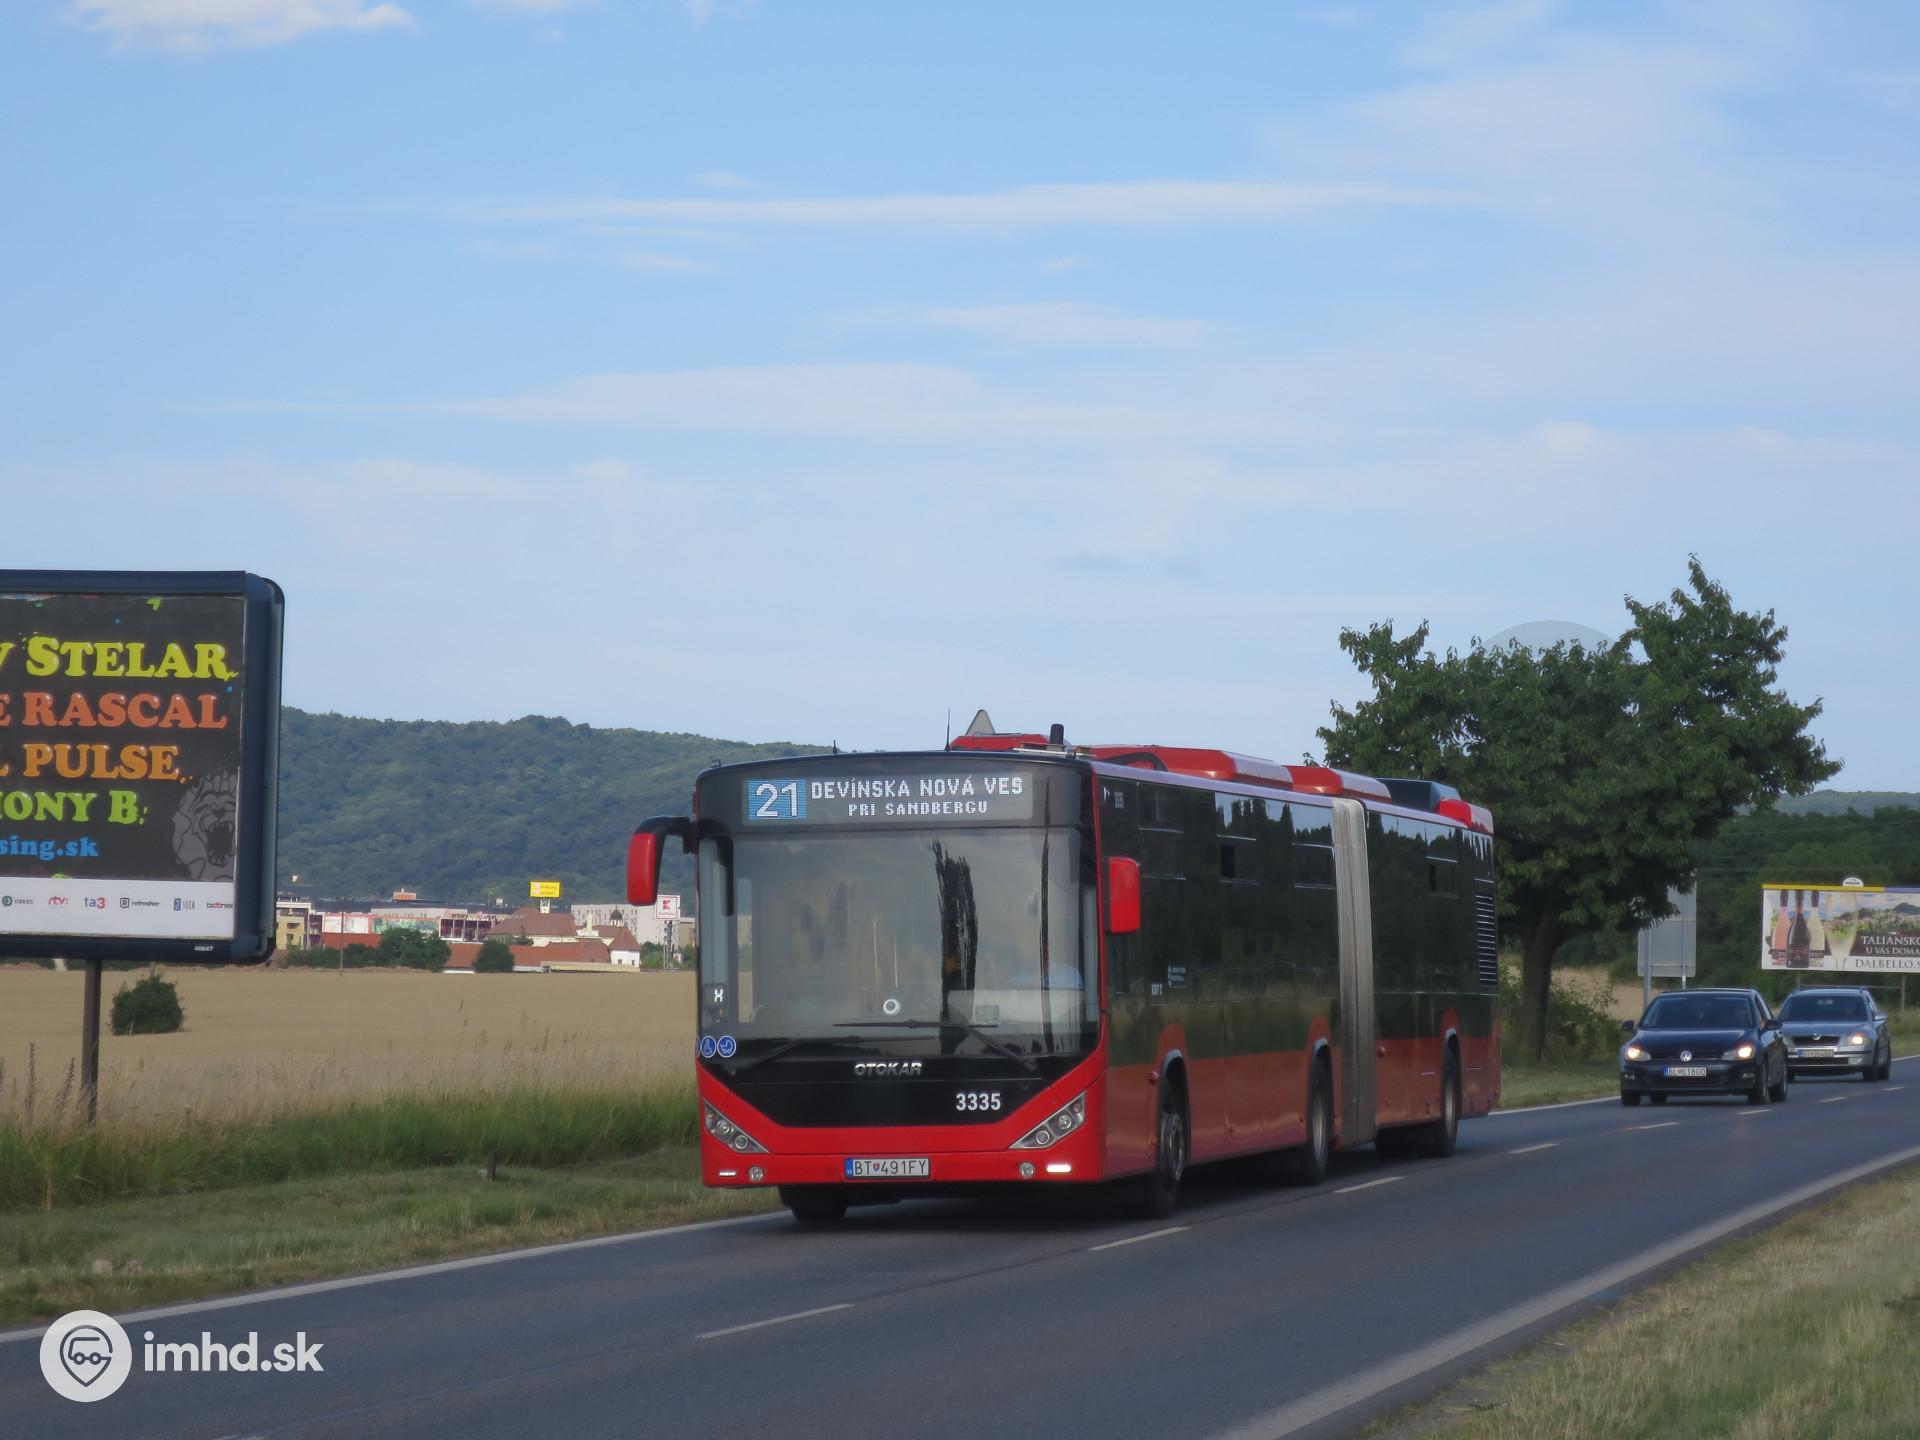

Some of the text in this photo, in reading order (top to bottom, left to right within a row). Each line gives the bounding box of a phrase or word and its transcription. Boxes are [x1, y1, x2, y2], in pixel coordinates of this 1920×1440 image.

[26, 636, 230, 679] STELAR
[22, 692, 226, 728] RASCAL
[23, 743, 180, 780] PULSE
[0, 790, 98, 822] ONY
[756, 775, 1023, 817] 21 DEVÍNSKA NOVÁ VES
[848, 800, 988, 816] PRI SANDBERGU
[84, 897, 106, 909] ta3
[854, 1062, 922, 1076] OTOKAR
[956, 1093, 1001, 1111] 3335
